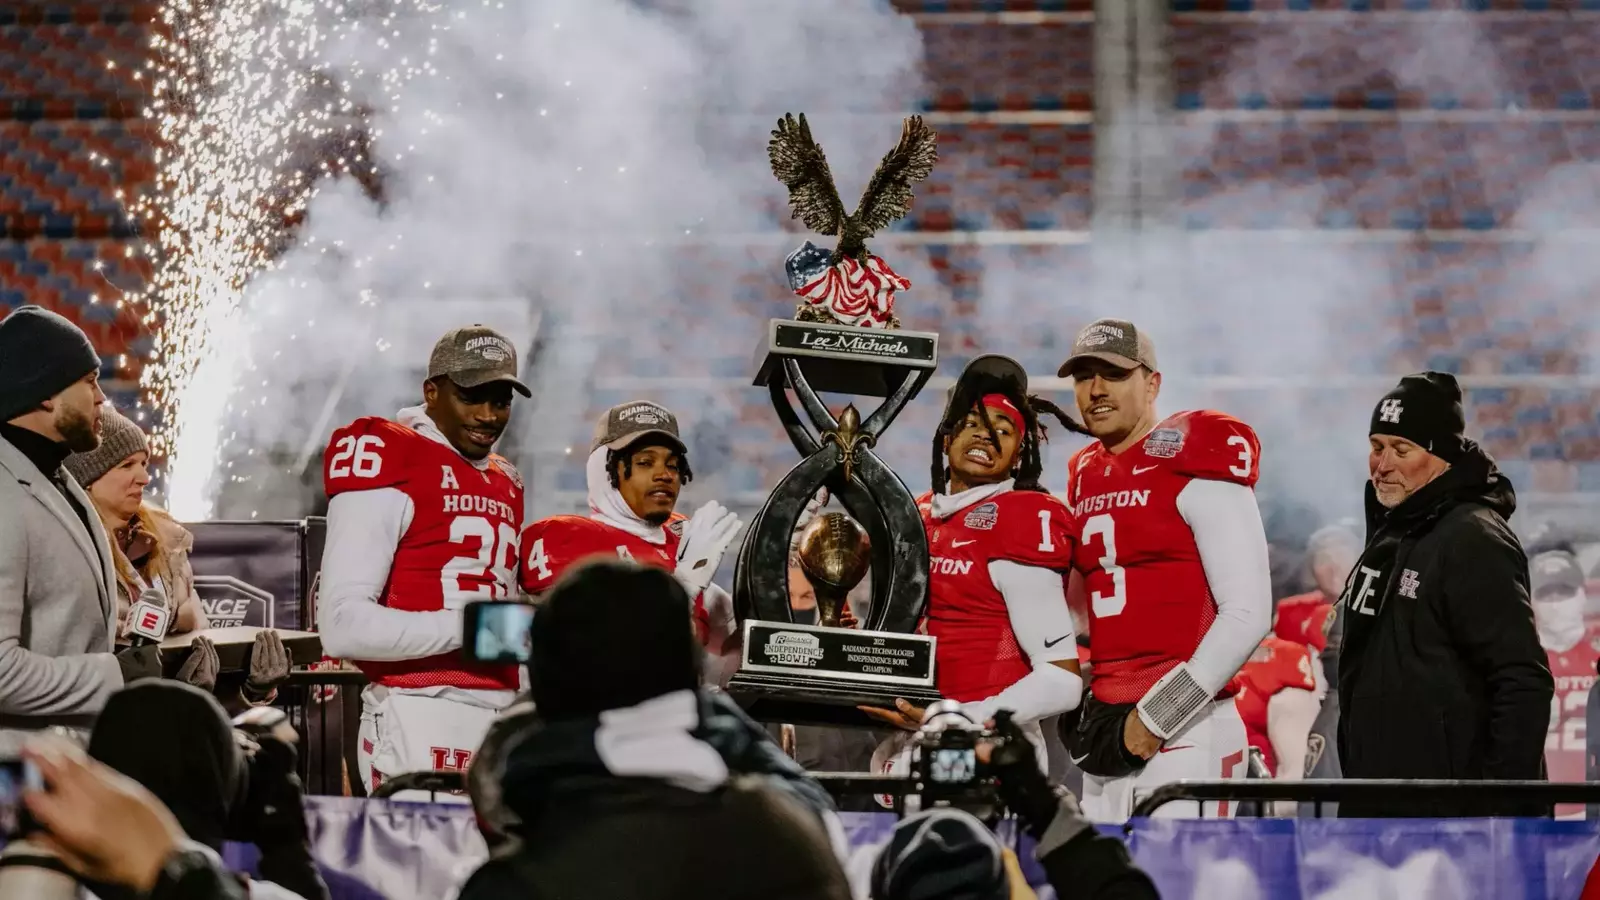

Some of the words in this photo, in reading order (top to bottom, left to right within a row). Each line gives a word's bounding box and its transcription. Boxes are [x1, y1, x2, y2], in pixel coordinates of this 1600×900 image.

[800, 332, 837, 347] Lee
[835, 335, 909, 354] Michaels
[619, 405, 670, 423] CHAMPIONS
[329, 434, 386, 480] 26
[1226, 435, 1253, 478] 3
[440, 464, 460, 490] A
[1075, 489, 1151, 519] OUSTON
[1038, 509, 1055, 552] 1
[528, 538, 552, 581] 4
[1081, 513, 1127, 619] 3
[1346, 563, 1381, 616] TE
[201, 598, 251, 615] NCE
[765, 644, 824, 658] INDEPENDENCE
[841, 644, 871, 654] RADIANCE
[871, 647, 915, 657] TECHNOLOGIES
[873, 638, 885, 646] 2022
[779, 653, 808, 664] BOWL
[847, 654, 892, 665] INDEPENDENCE
[892, 658, 909, 666] BOWL
[862, 664, 893, 674] CHAMPION
